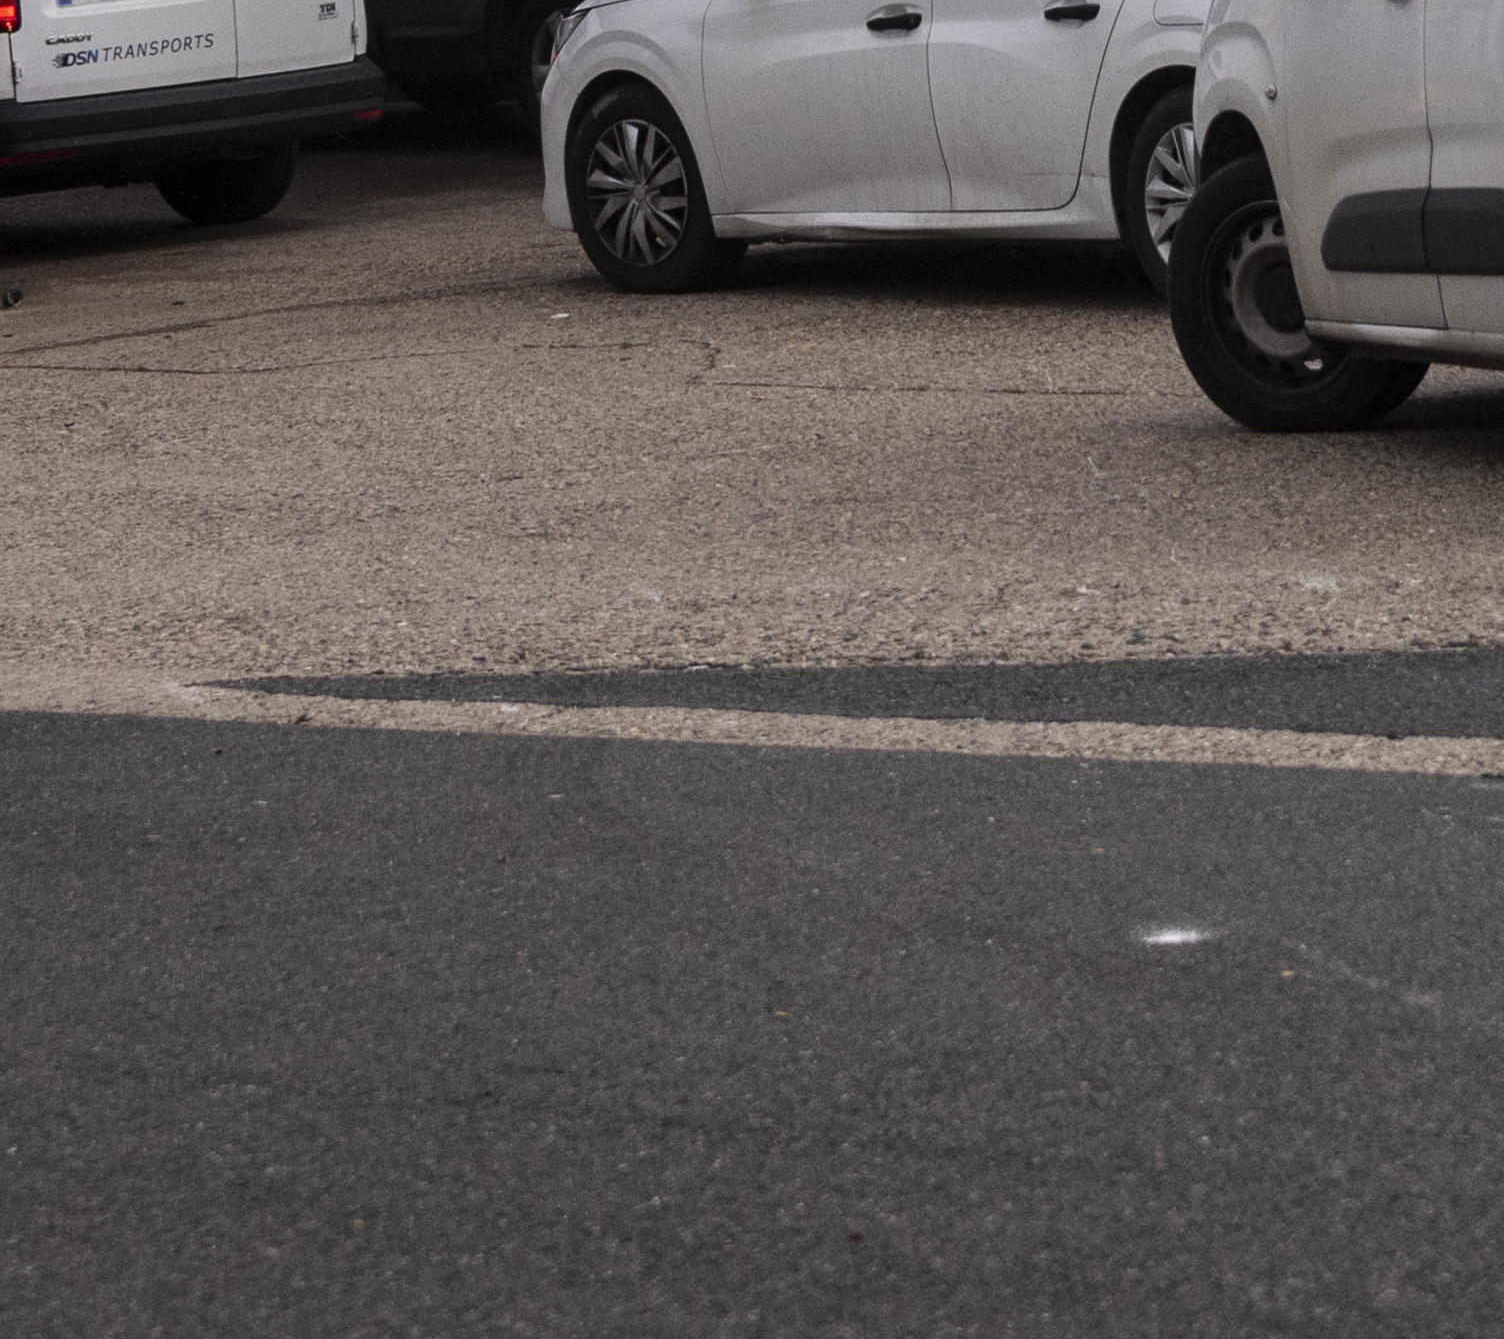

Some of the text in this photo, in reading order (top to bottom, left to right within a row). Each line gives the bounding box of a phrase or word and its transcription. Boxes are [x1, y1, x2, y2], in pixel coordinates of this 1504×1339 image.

[319, 2, 336, 13] TDI
[45, 32, 94, 45] CADDY
[59, 33, 214, 69] DSN TRANSPORTS
